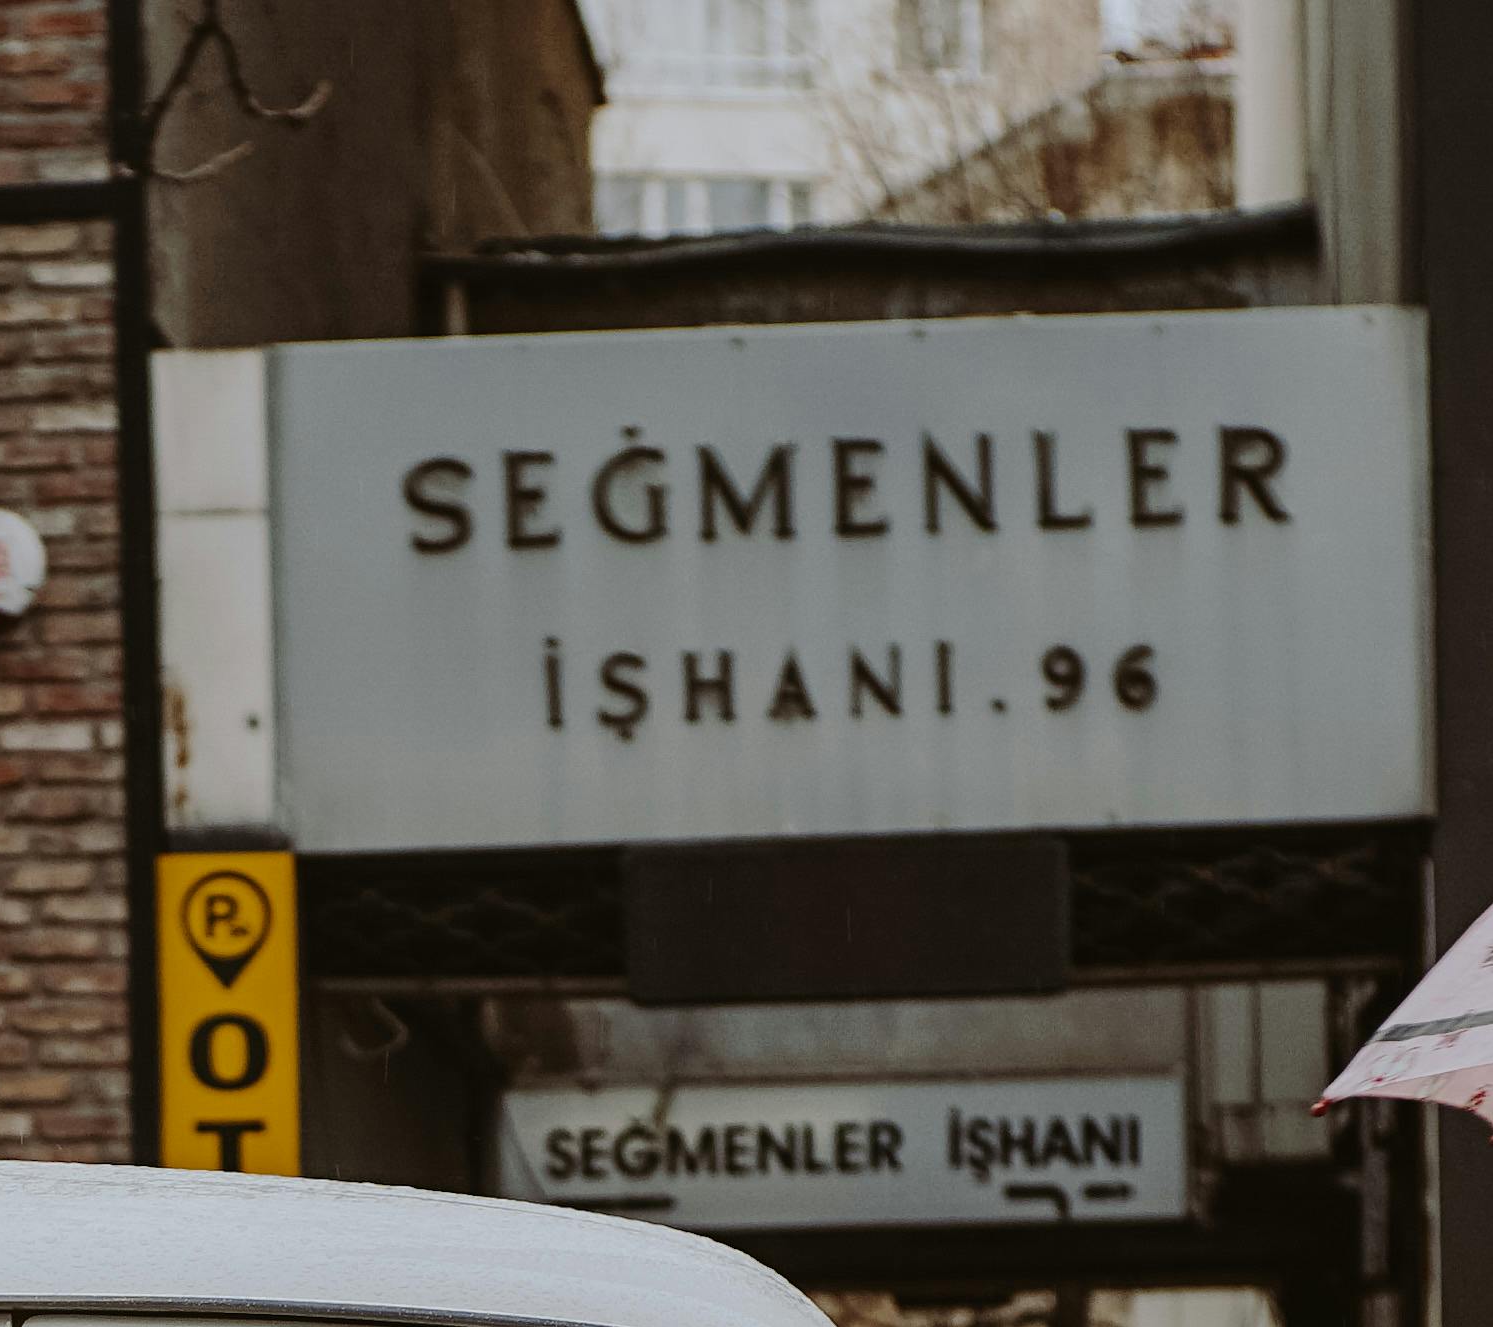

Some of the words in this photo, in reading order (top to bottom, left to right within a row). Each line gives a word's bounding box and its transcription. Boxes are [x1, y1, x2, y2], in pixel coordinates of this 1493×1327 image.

[401, 422, 1292, 553] SEĞMENLER
[545, 1114, 903, 1183] SEĞMENLER
[948, 1106, 1142, 1184] İŞHANI
